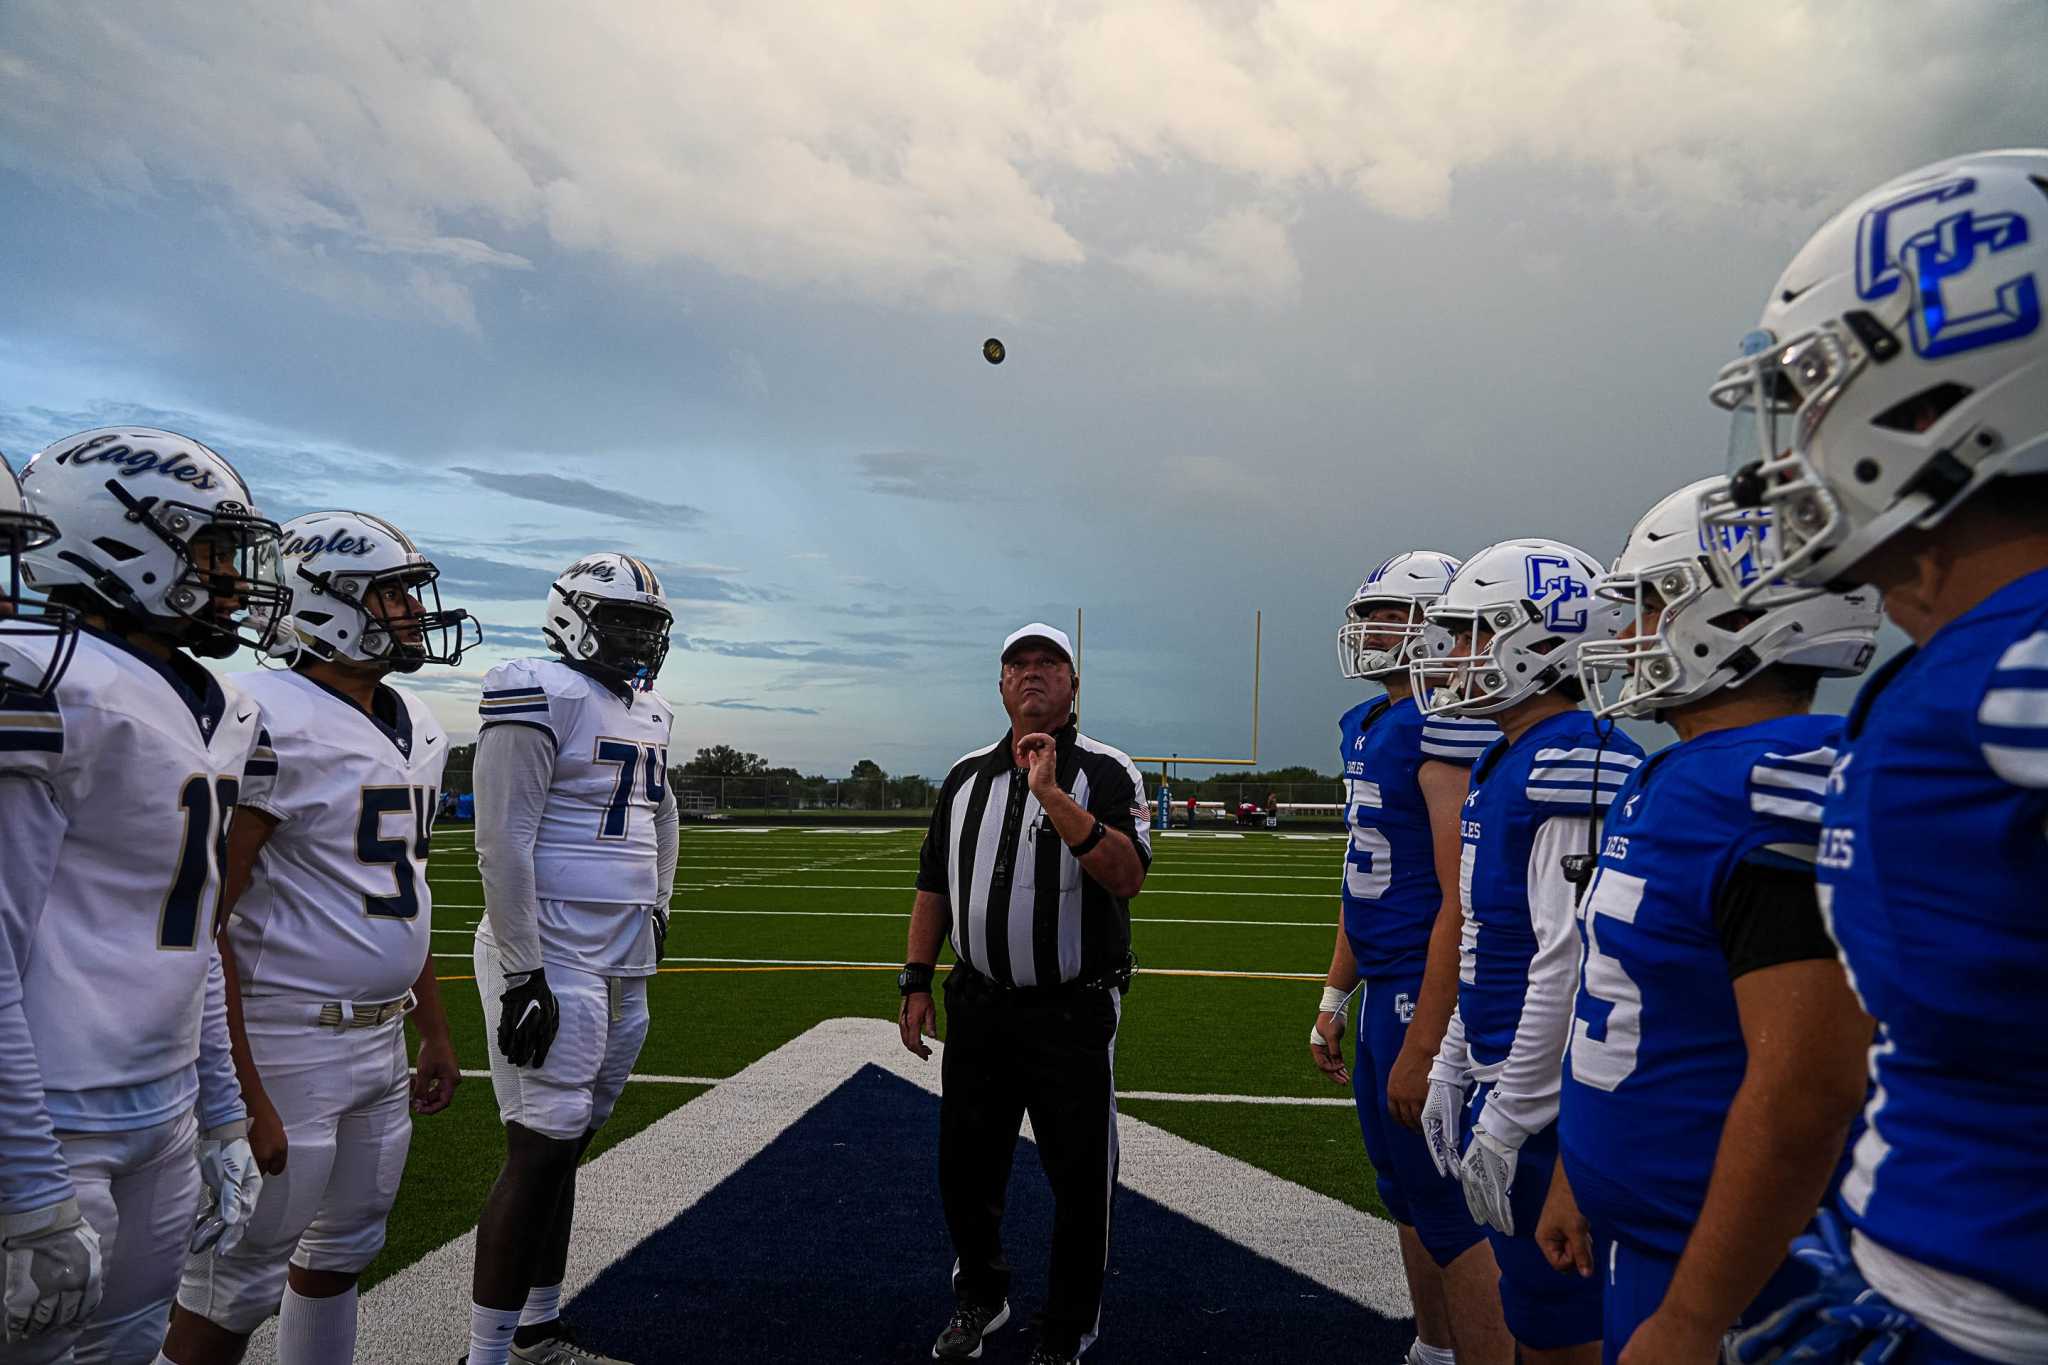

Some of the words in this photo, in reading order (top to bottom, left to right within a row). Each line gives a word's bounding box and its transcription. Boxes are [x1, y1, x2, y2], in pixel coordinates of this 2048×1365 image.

[71, 434, 217, 490] Eagles
[353, 784, 437, 922] 54
[1344, 778, 1392, 900] 5
[1566, 867, 1648, 1093] 5
